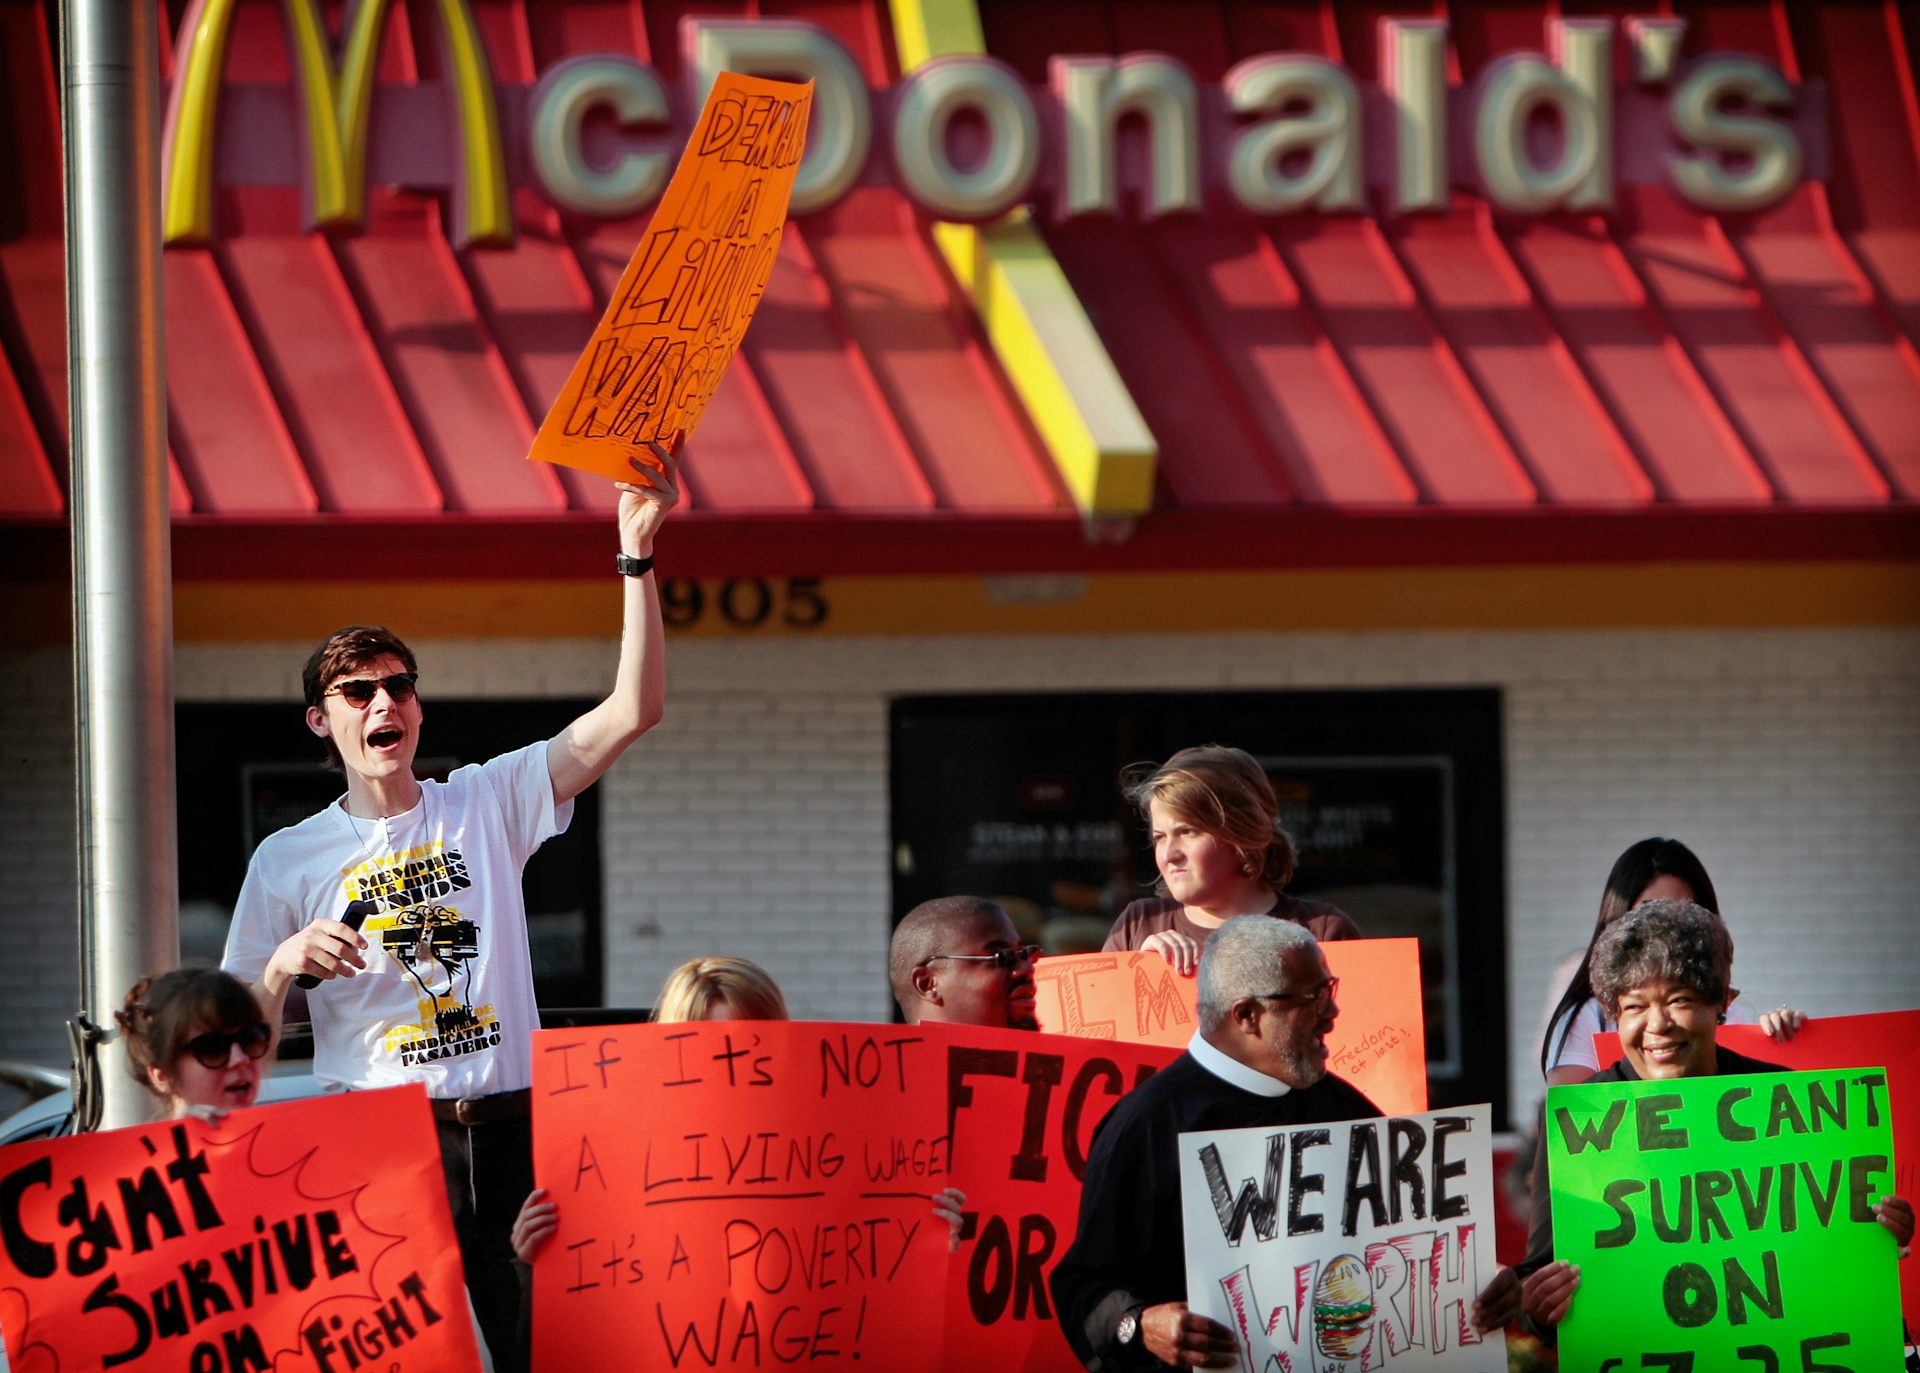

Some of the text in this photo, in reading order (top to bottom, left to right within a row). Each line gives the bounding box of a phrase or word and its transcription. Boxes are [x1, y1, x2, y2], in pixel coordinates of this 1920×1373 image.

[358, 849, 464, 890] MEMPHIS
[400, 1026, 484, 1054] SINDICATO
[402, 1033, 501, 1067] PASAJERO
[663, 1032, 773, 1087] It's
[821, 1034, 924, 1098] NOT
[1332, 1025, 1395, 1071] Freedom
[1351, 1028, 1412, 1074] at last!
[1553, 1074, 1886, 1156] WE CAN'T
[574, 1132, 948, 1193] A LIVING WAGE
[1197, 1117, 1475, 1248] WE ARE
[0, 1124, 225, 1279] Can't
[1594, 1154, 1889, 1249] SURVIVE
[566, 1219, 921, 1295] It's A POVERTY
[1662, 1250, 1785, 1329] ON
[656, 1296, 867, 1369] WAGE!
